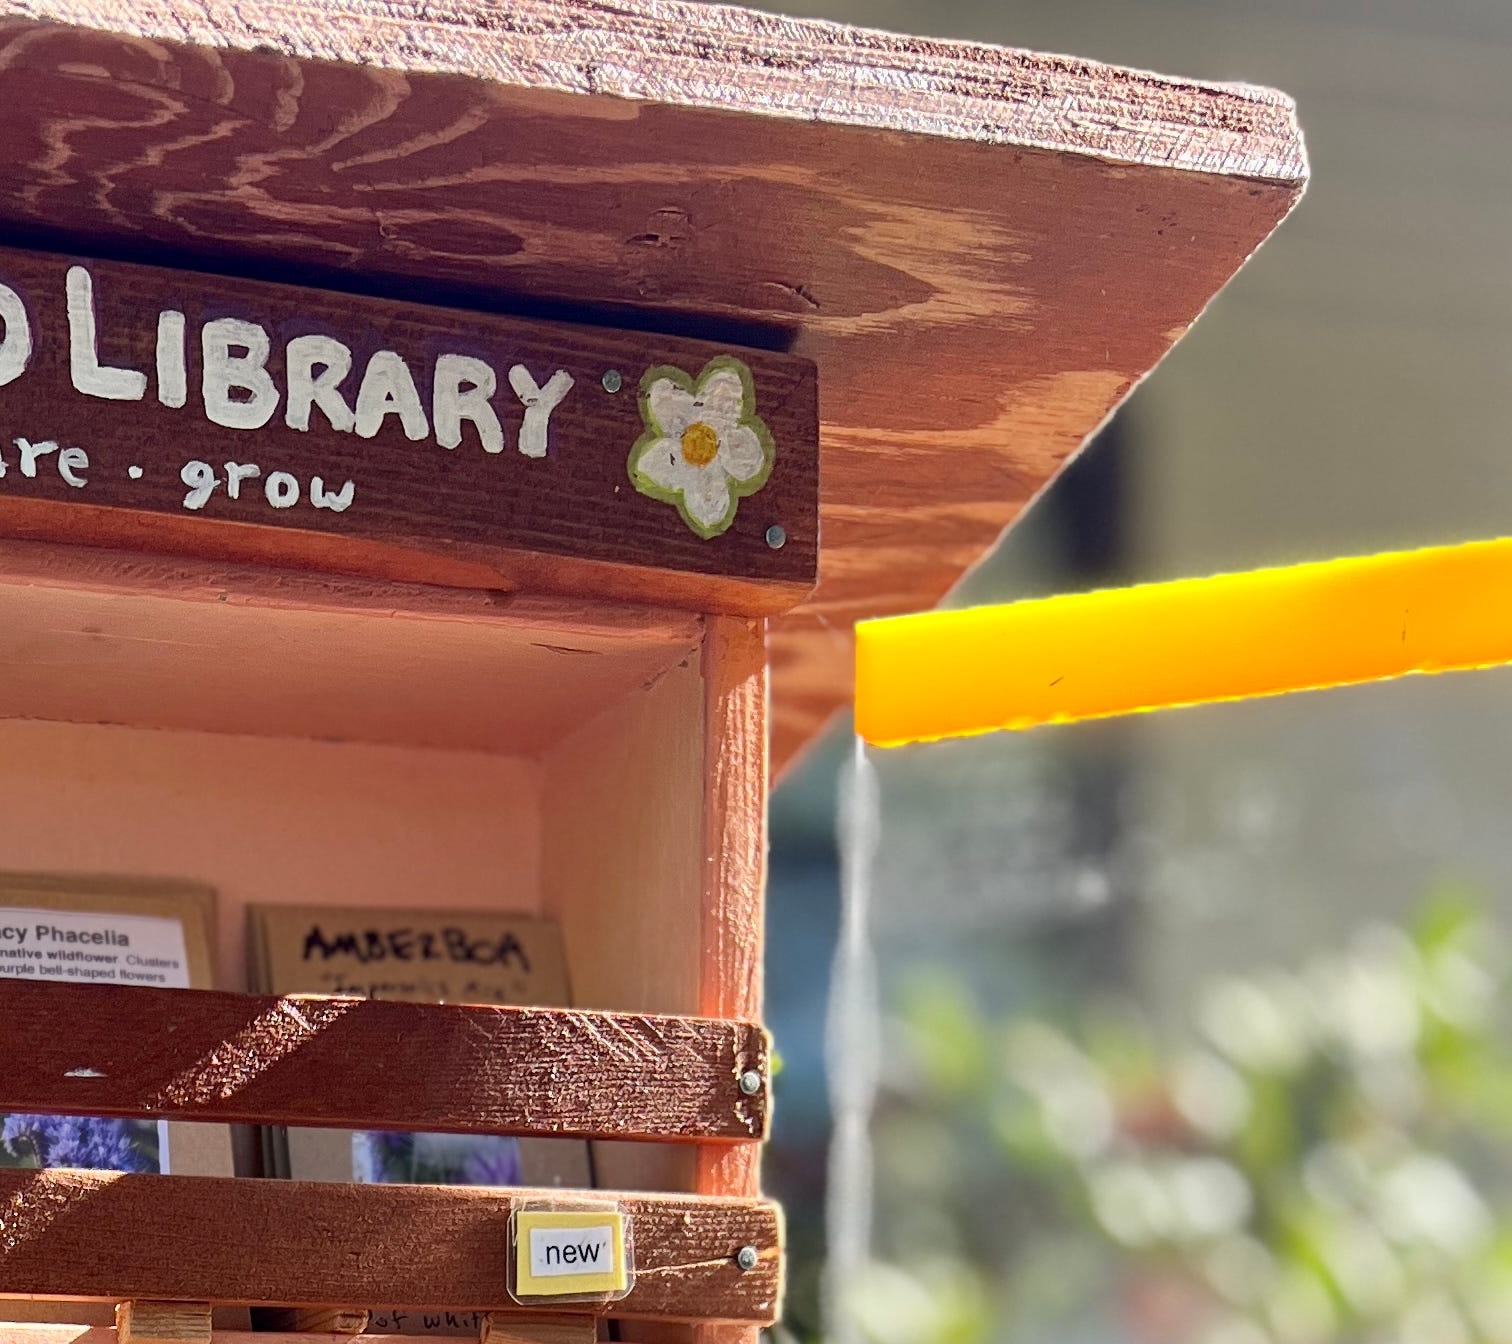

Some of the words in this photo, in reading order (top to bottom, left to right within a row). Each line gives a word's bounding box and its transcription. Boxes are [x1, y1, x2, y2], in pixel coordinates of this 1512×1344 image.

[65, 266, 575, 458] LIBRARY
[181, 460, 356, 512] grow
[36, 924, 130, 948] Phacelia
[0, 948, 43, 960] native
[39, 965, 116, 980] bell-shaped
[545, 1239, 601, 1266] new
